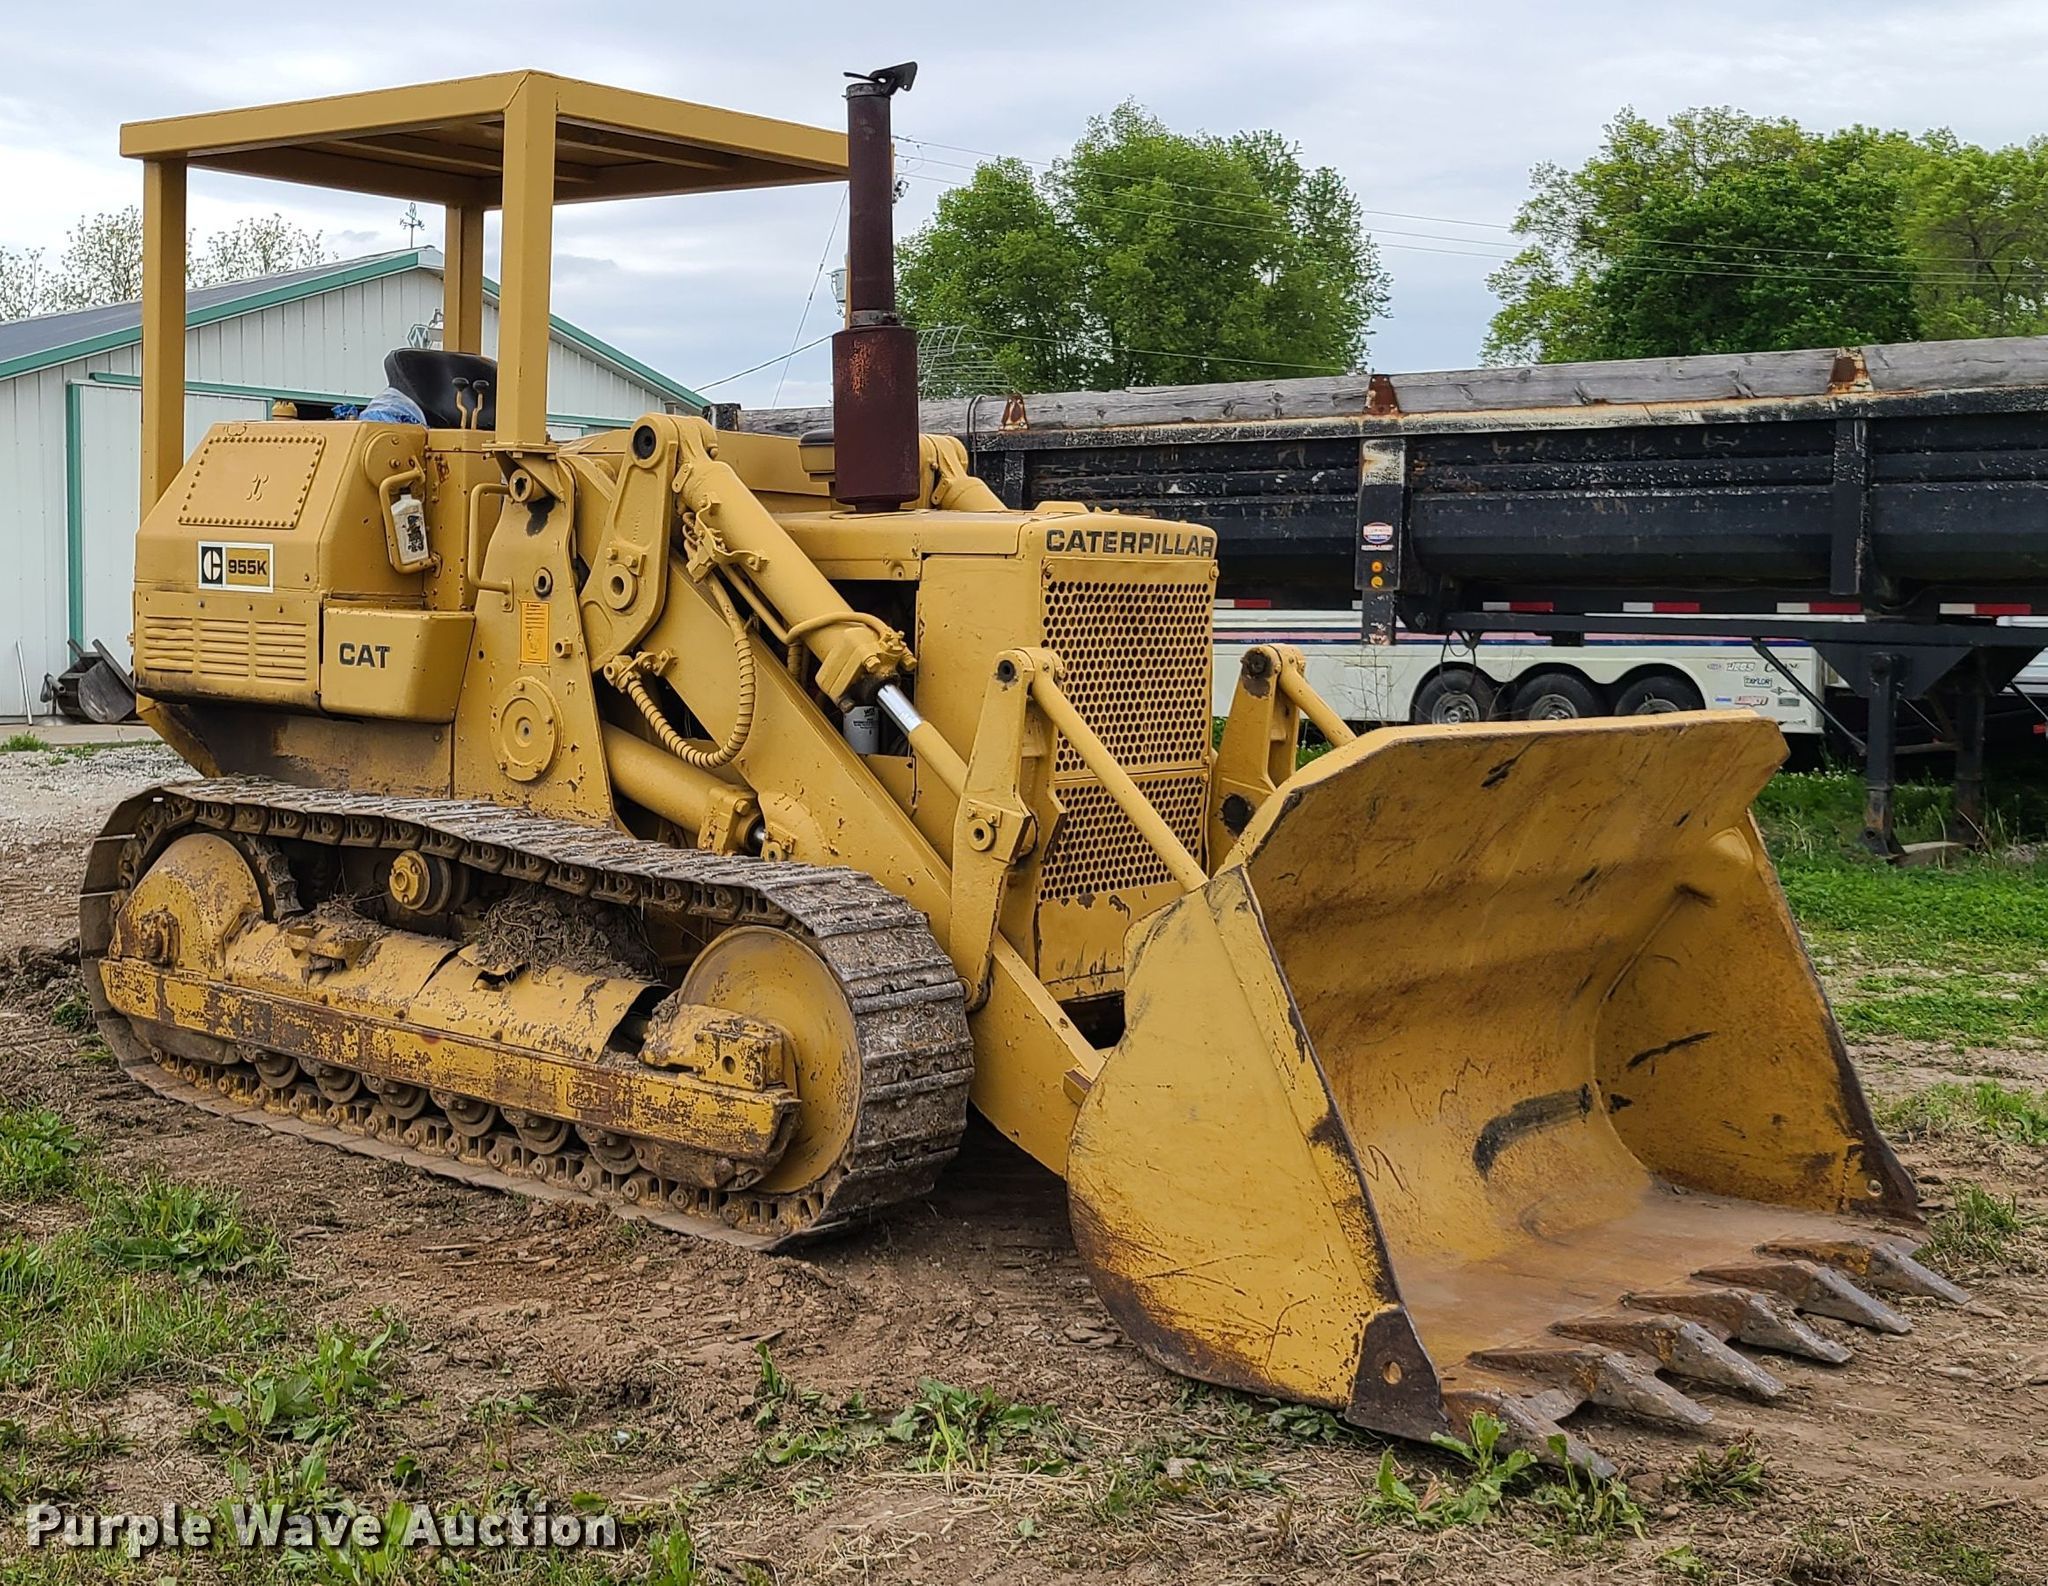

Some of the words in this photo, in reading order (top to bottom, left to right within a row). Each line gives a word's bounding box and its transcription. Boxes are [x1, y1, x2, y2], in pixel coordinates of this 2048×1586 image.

[1046, 529, 1214, 558] CATERPILLAR
[228, 559, 267, 576] 955K
[339, 642, 391, 668] CAT
